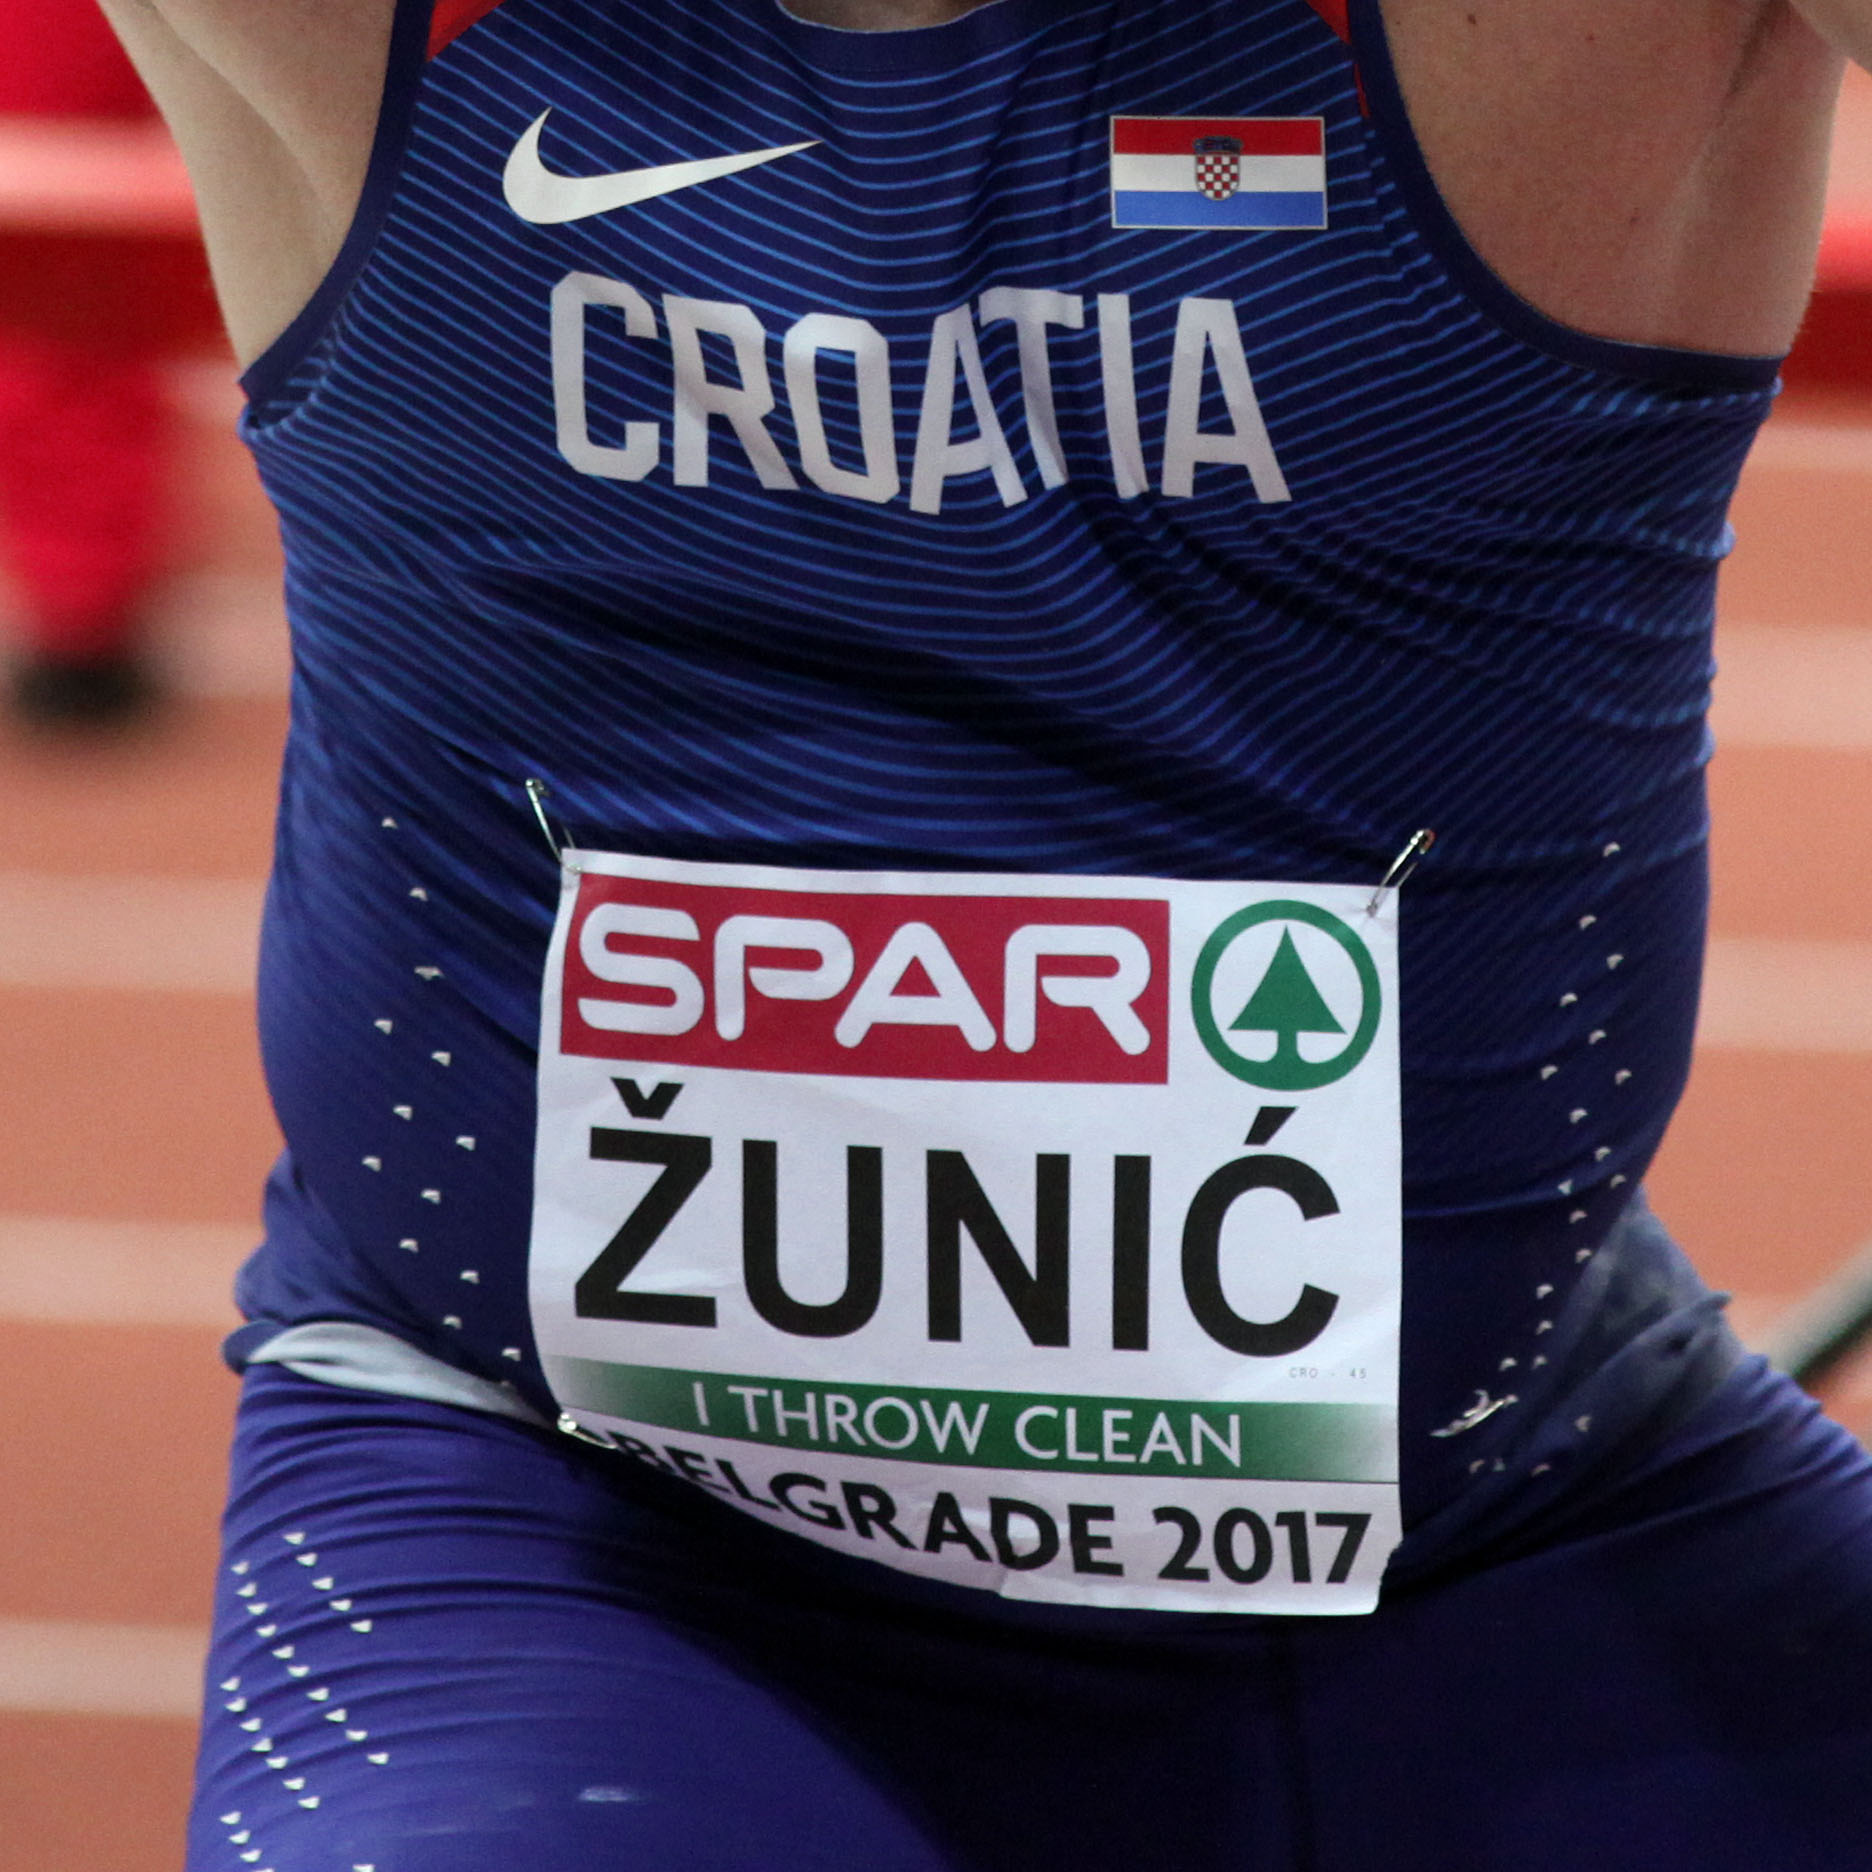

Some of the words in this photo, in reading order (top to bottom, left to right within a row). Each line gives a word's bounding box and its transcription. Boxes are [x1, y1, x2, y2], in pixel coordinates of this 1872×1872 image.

[550, 271, 1292, 515] CROATIA
[578, 902, 1151, 1056] SPAR
[574, 1077, 1341, 1357] ŽUNIĆ
[693, 1382, 709, 1427] I
[728, 1386, 989, 1455] THROW
[1015, 1406, 1241, 1468] CLEAN
[1288, 1367, 1319, 1379] CRO
[607, 1431, 1124, 1576] BELGRADE
[1151, 1506, 1372, 1584] 2017
